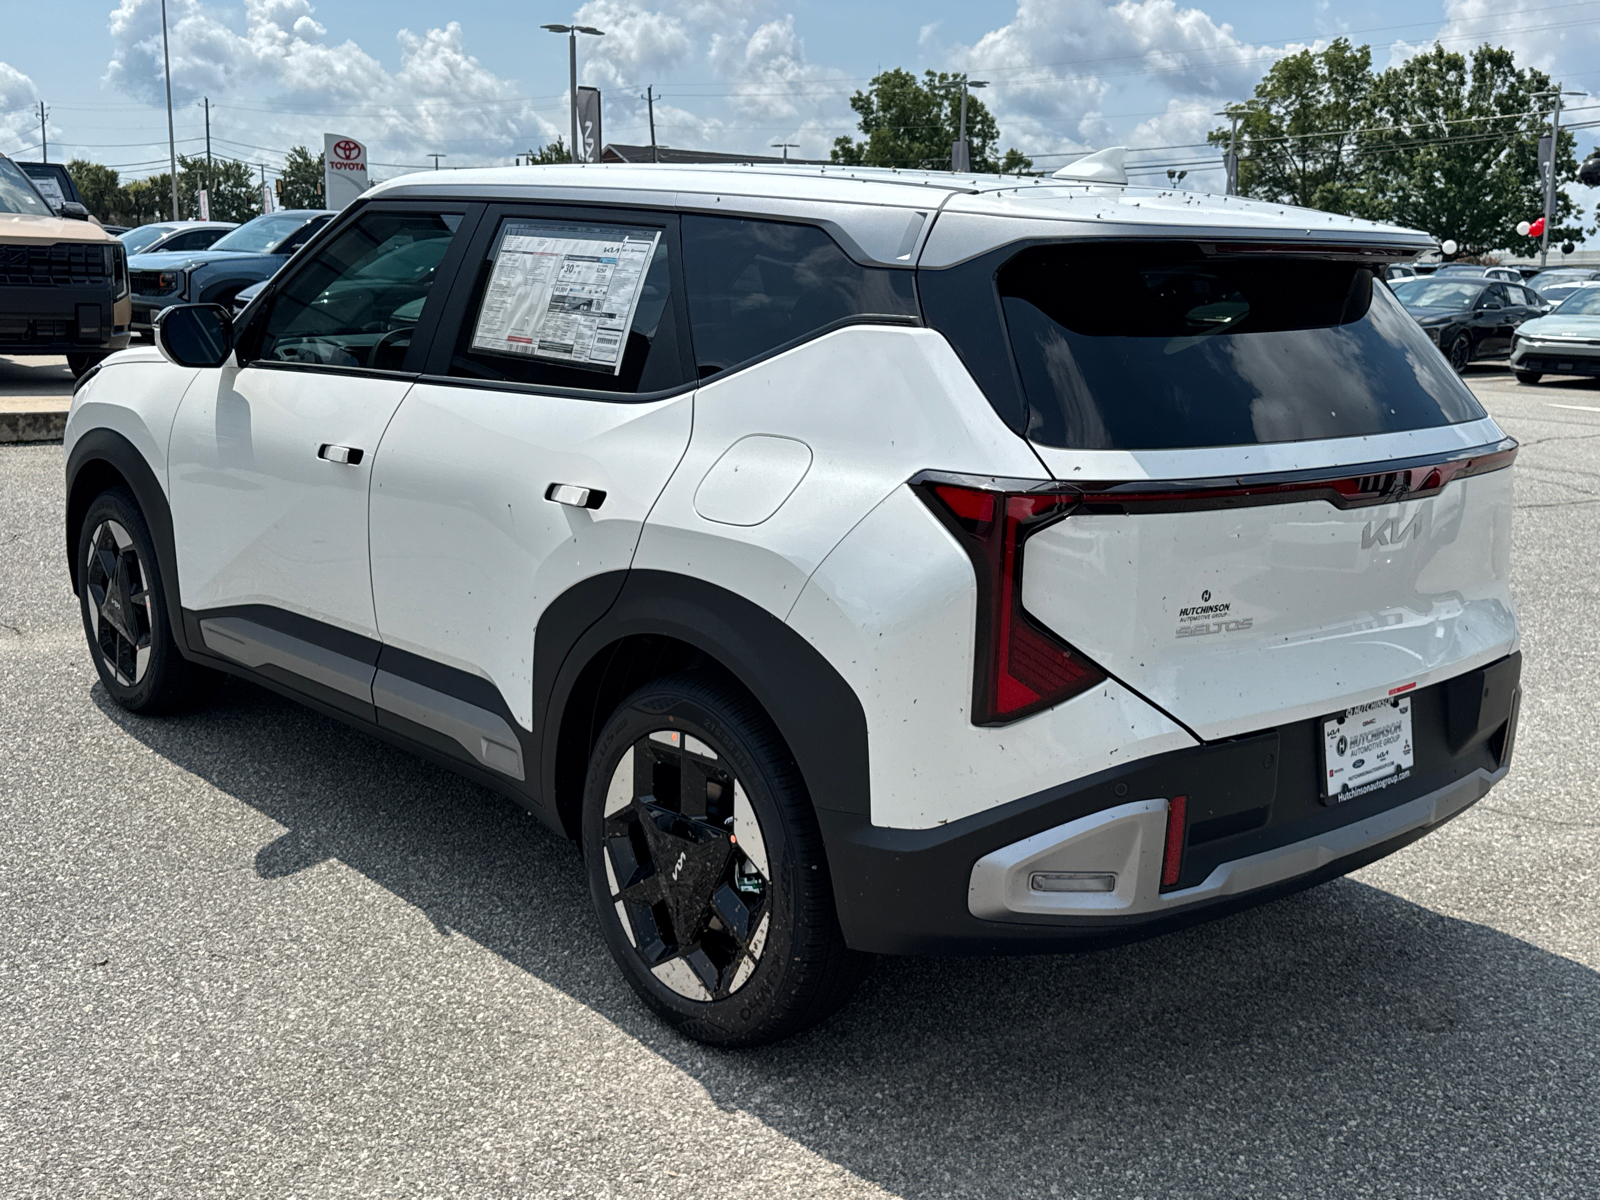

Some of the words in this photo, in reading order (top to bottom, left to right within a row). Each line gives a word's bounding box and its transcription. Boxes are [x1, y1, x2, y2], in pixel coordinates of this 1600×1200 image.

[329, 161, 366, 171] TOYOTA
[564, 263, 574, 273] 30
[1361, 512, 1422, 549] KIA
[1179, 602, 1231, 617] HUTCHINSON
[1180, 613, 1210, 623] AUTOMOTIVE
[1211, 611, 1228, 620] GROUP
[1175, 617, 1254, 639] SELTOS
[1349, 720, 1404, 749] HUTCHINSON
[1350, 739, 1383, 757] AUTOMOTIVE
[1383, 733, 1401, 746] GROUP
[1337, 770, 1411, 802] Hutchinsonautogroup.com
[672, 851, 686, 881] KIA
